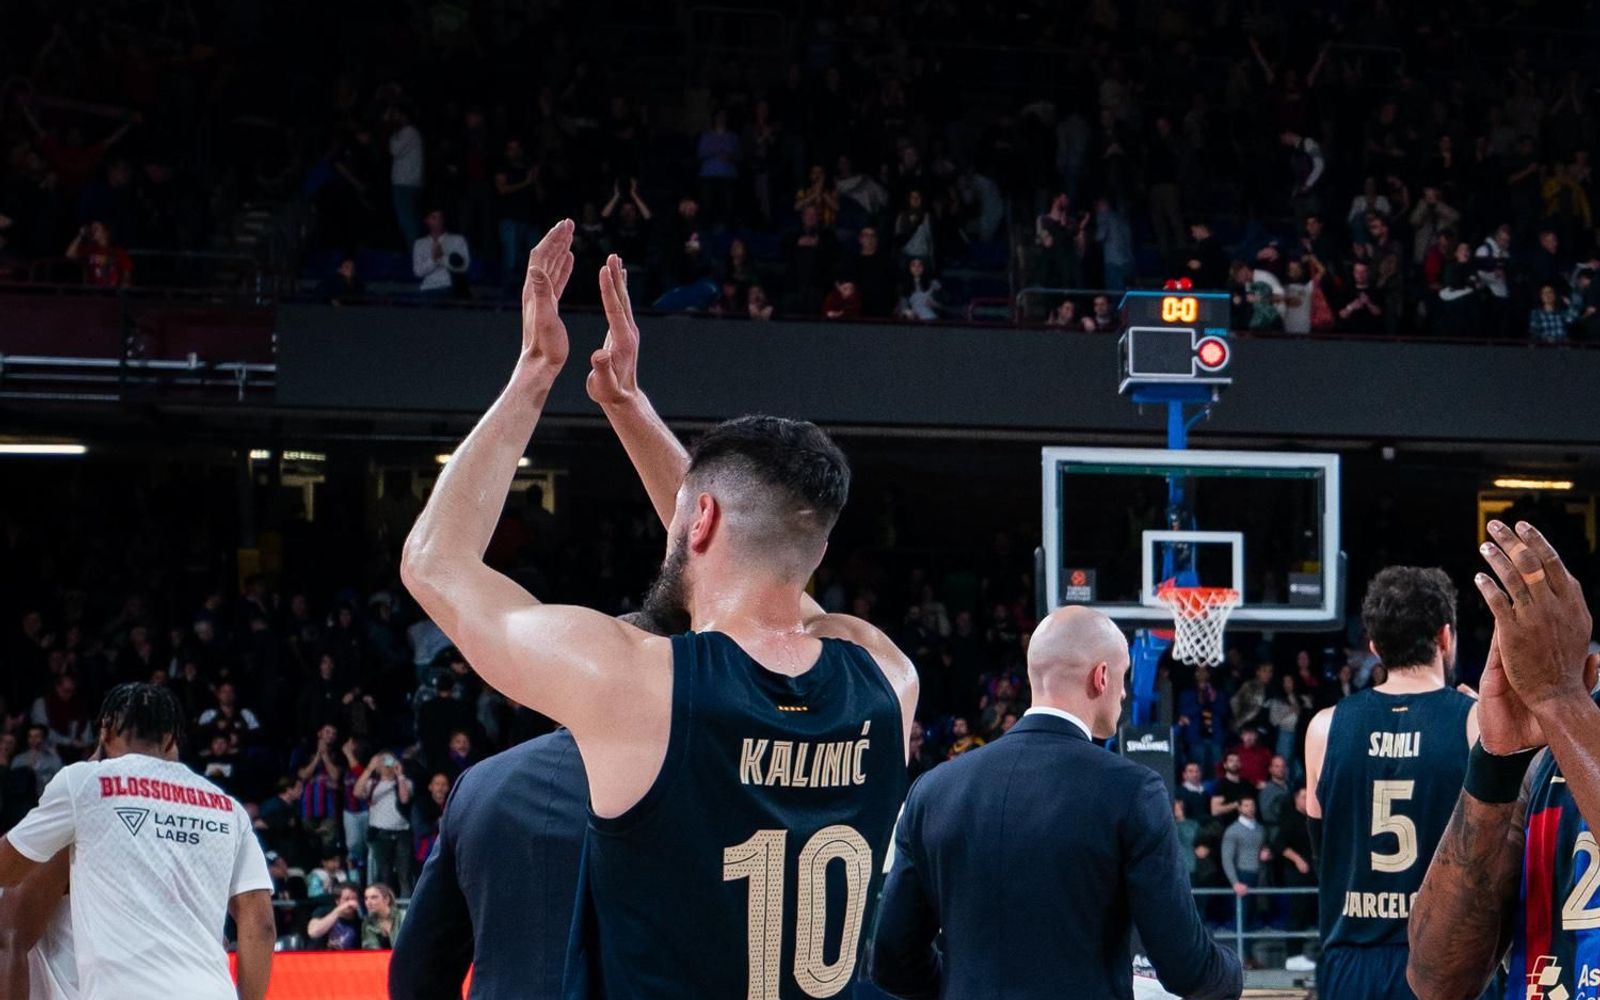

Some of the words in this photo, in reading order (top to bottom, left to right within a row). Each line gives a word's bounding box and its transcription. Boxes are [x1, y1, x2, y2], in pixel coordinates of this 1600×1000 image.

[739, 719, 871, 788] KALINIĆ
[1368, 731, 1421, 758] SANLI
[154, 812, 230, 835] LATTICE
[156, 827, 200, 845] LABS
[1371, 780, 1418, 873] 5
